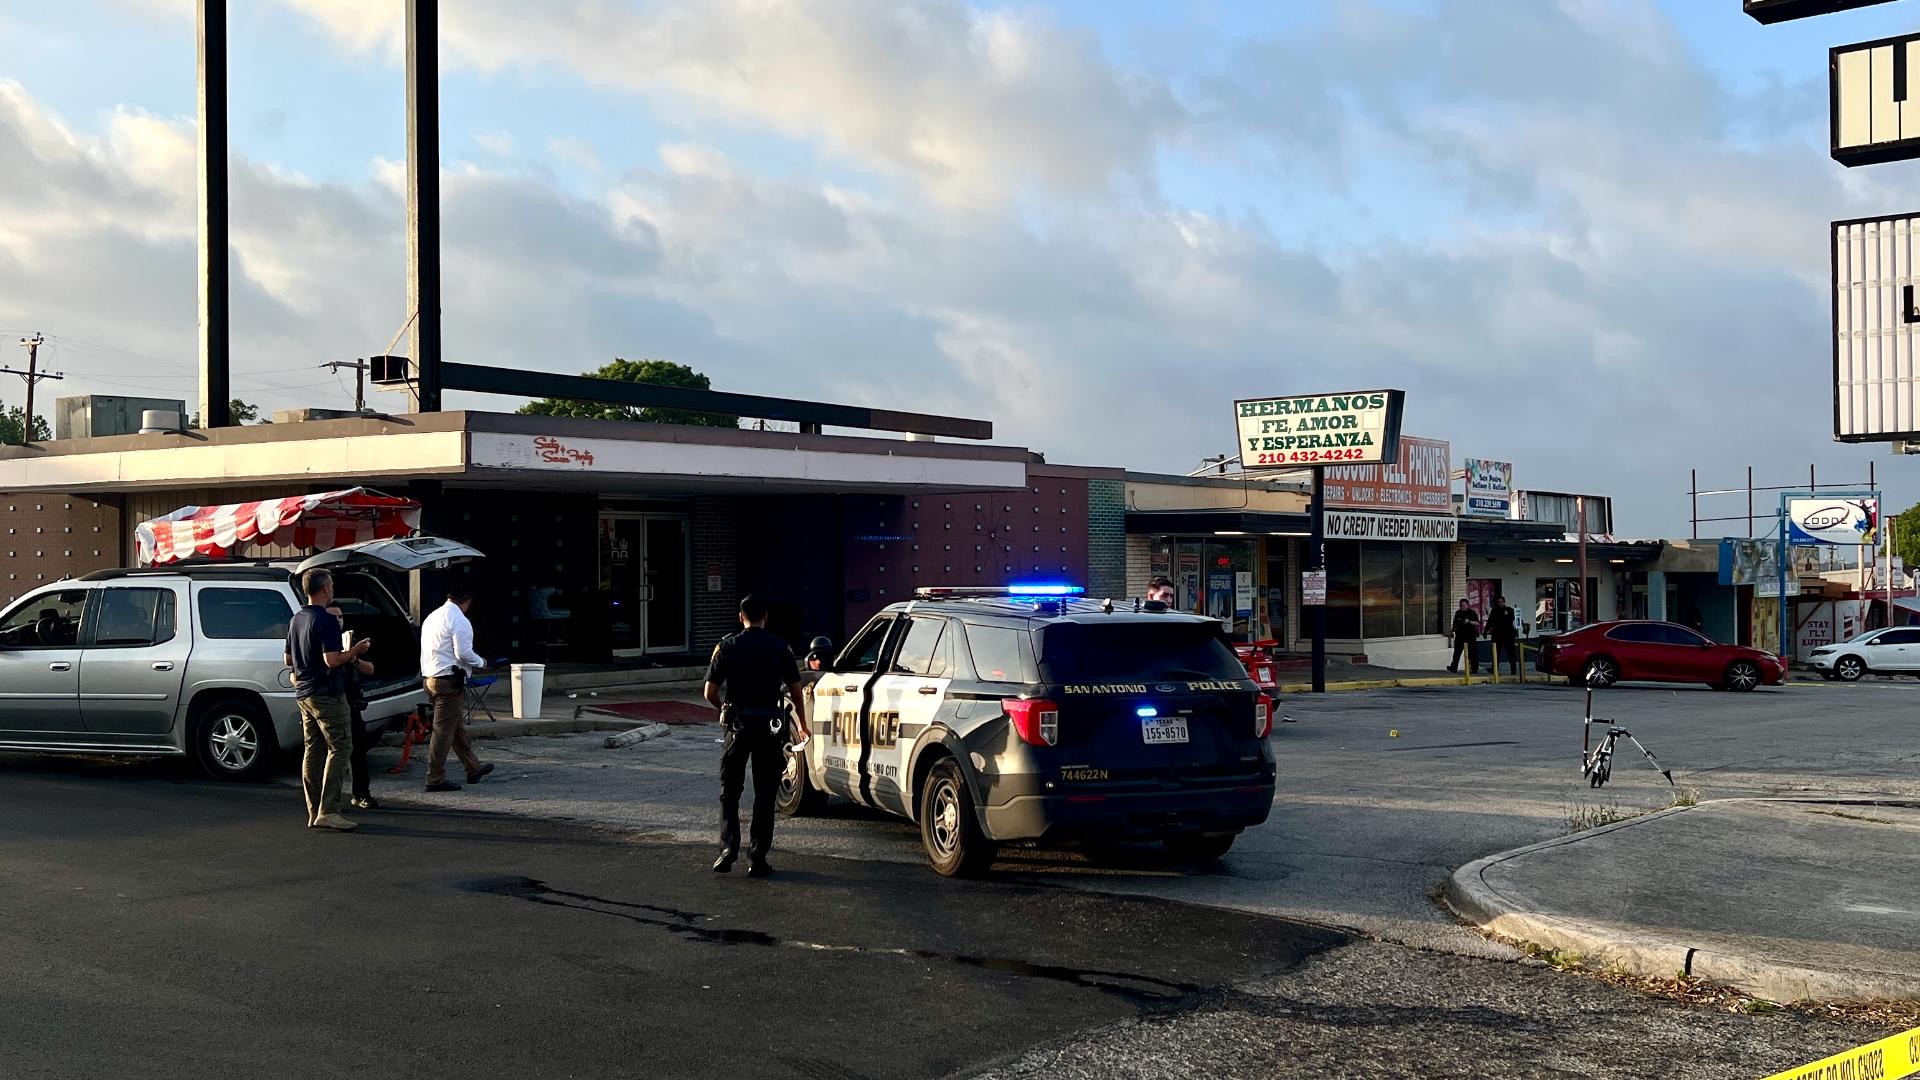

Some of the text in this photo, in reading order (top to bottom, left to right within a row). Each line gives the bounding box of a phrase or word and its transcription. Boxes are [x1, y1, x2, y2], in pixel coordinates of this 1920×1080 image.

[1240, 394, 1384, 417] HERMANOS
[1262, 415, 1358, 434] FE, AMOR
[1248, 432, 1373, 451] Y ESPERANZA
[1258, 448, 1363, 463] 210 432-4242
[1410, 444, 1447, 487] PHONES
[1381, 488, 1412, 503] ELECTRONICS
[1418, 491, 1447, 505] ACCESSORIES
[1327, 514, 1454, 539] NO CREDIT NEEDED FINANCING
[1210, 579, 1231, 590] REPAIR
[1808, 621, 1829, 629] STAY
[1064, 685, 1091, 694] SAN
[1092, 684, 1147, 694] ANTONIO
[1187, 681, 1242, 691] POLICE
[832, 711, 899, 749] POLICE
[886, 765, 898, 777] CITY
[1858, 1048, 1884, 1079] CROSS
